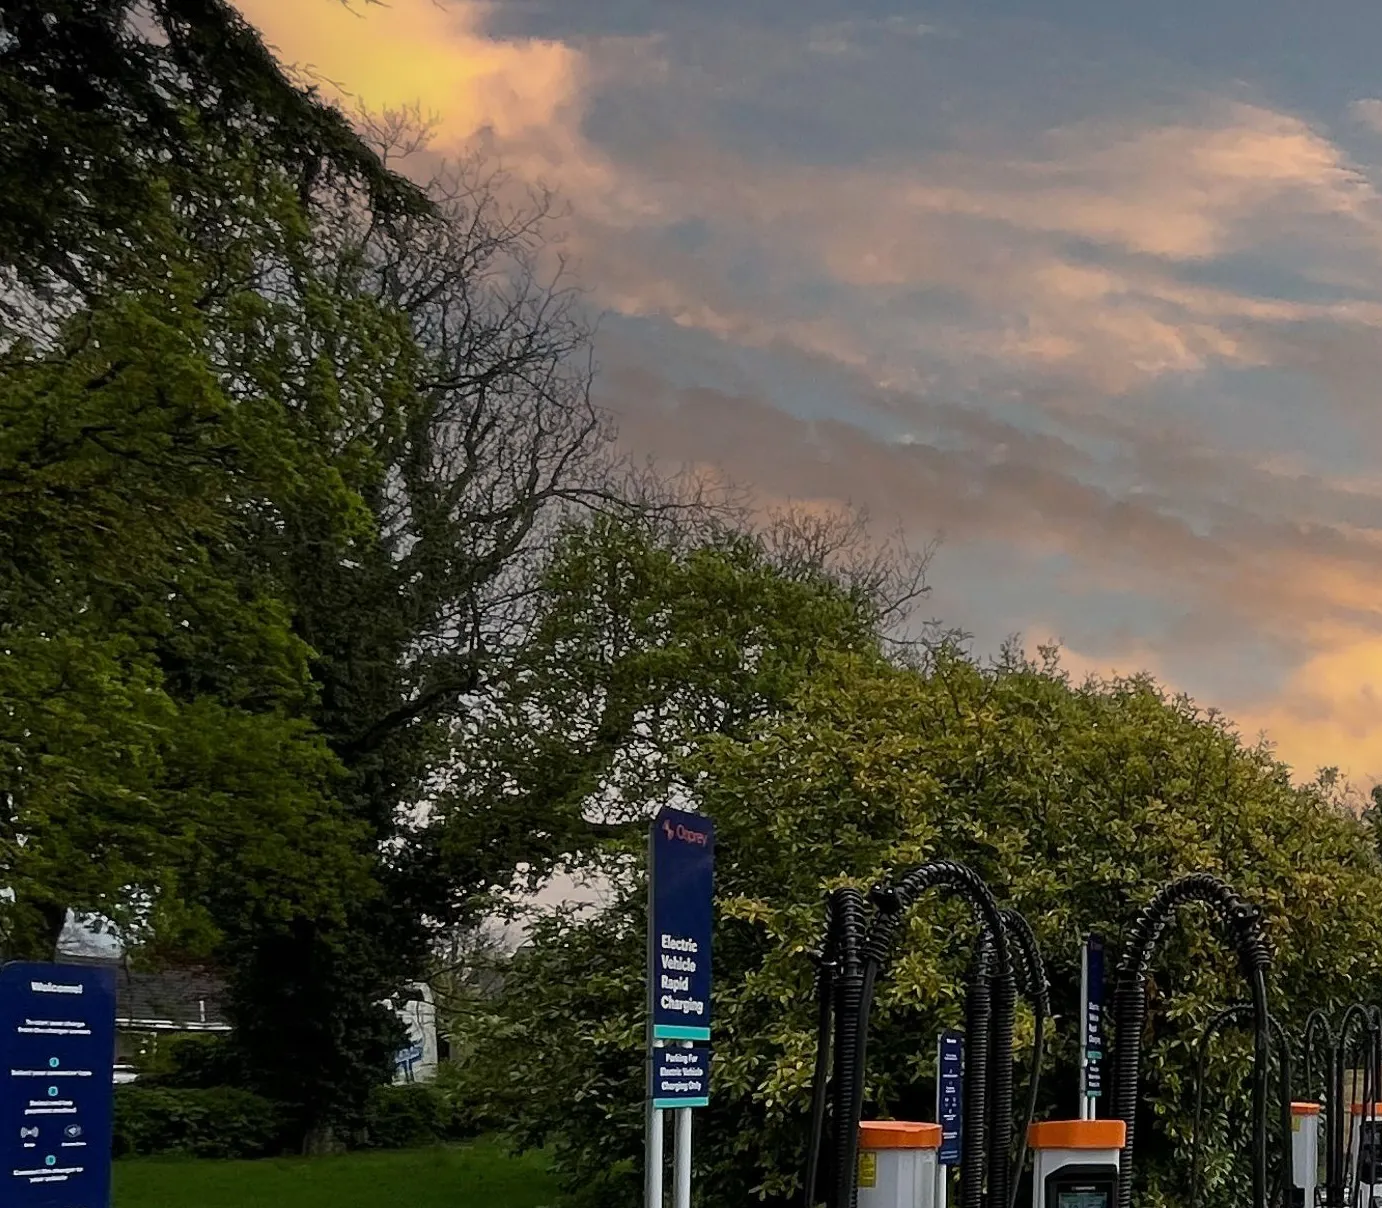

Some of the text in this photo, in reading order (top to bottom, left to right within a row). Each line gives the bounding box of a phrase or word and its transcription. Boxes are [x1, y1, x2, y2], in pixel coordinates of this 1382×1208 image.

[661, 934, 698, 953] Electric
[661, 954, 697, 973] Vehicle
[661, 974, 689, 993] Rapid
[661, 994, 704, 1015] Charging
